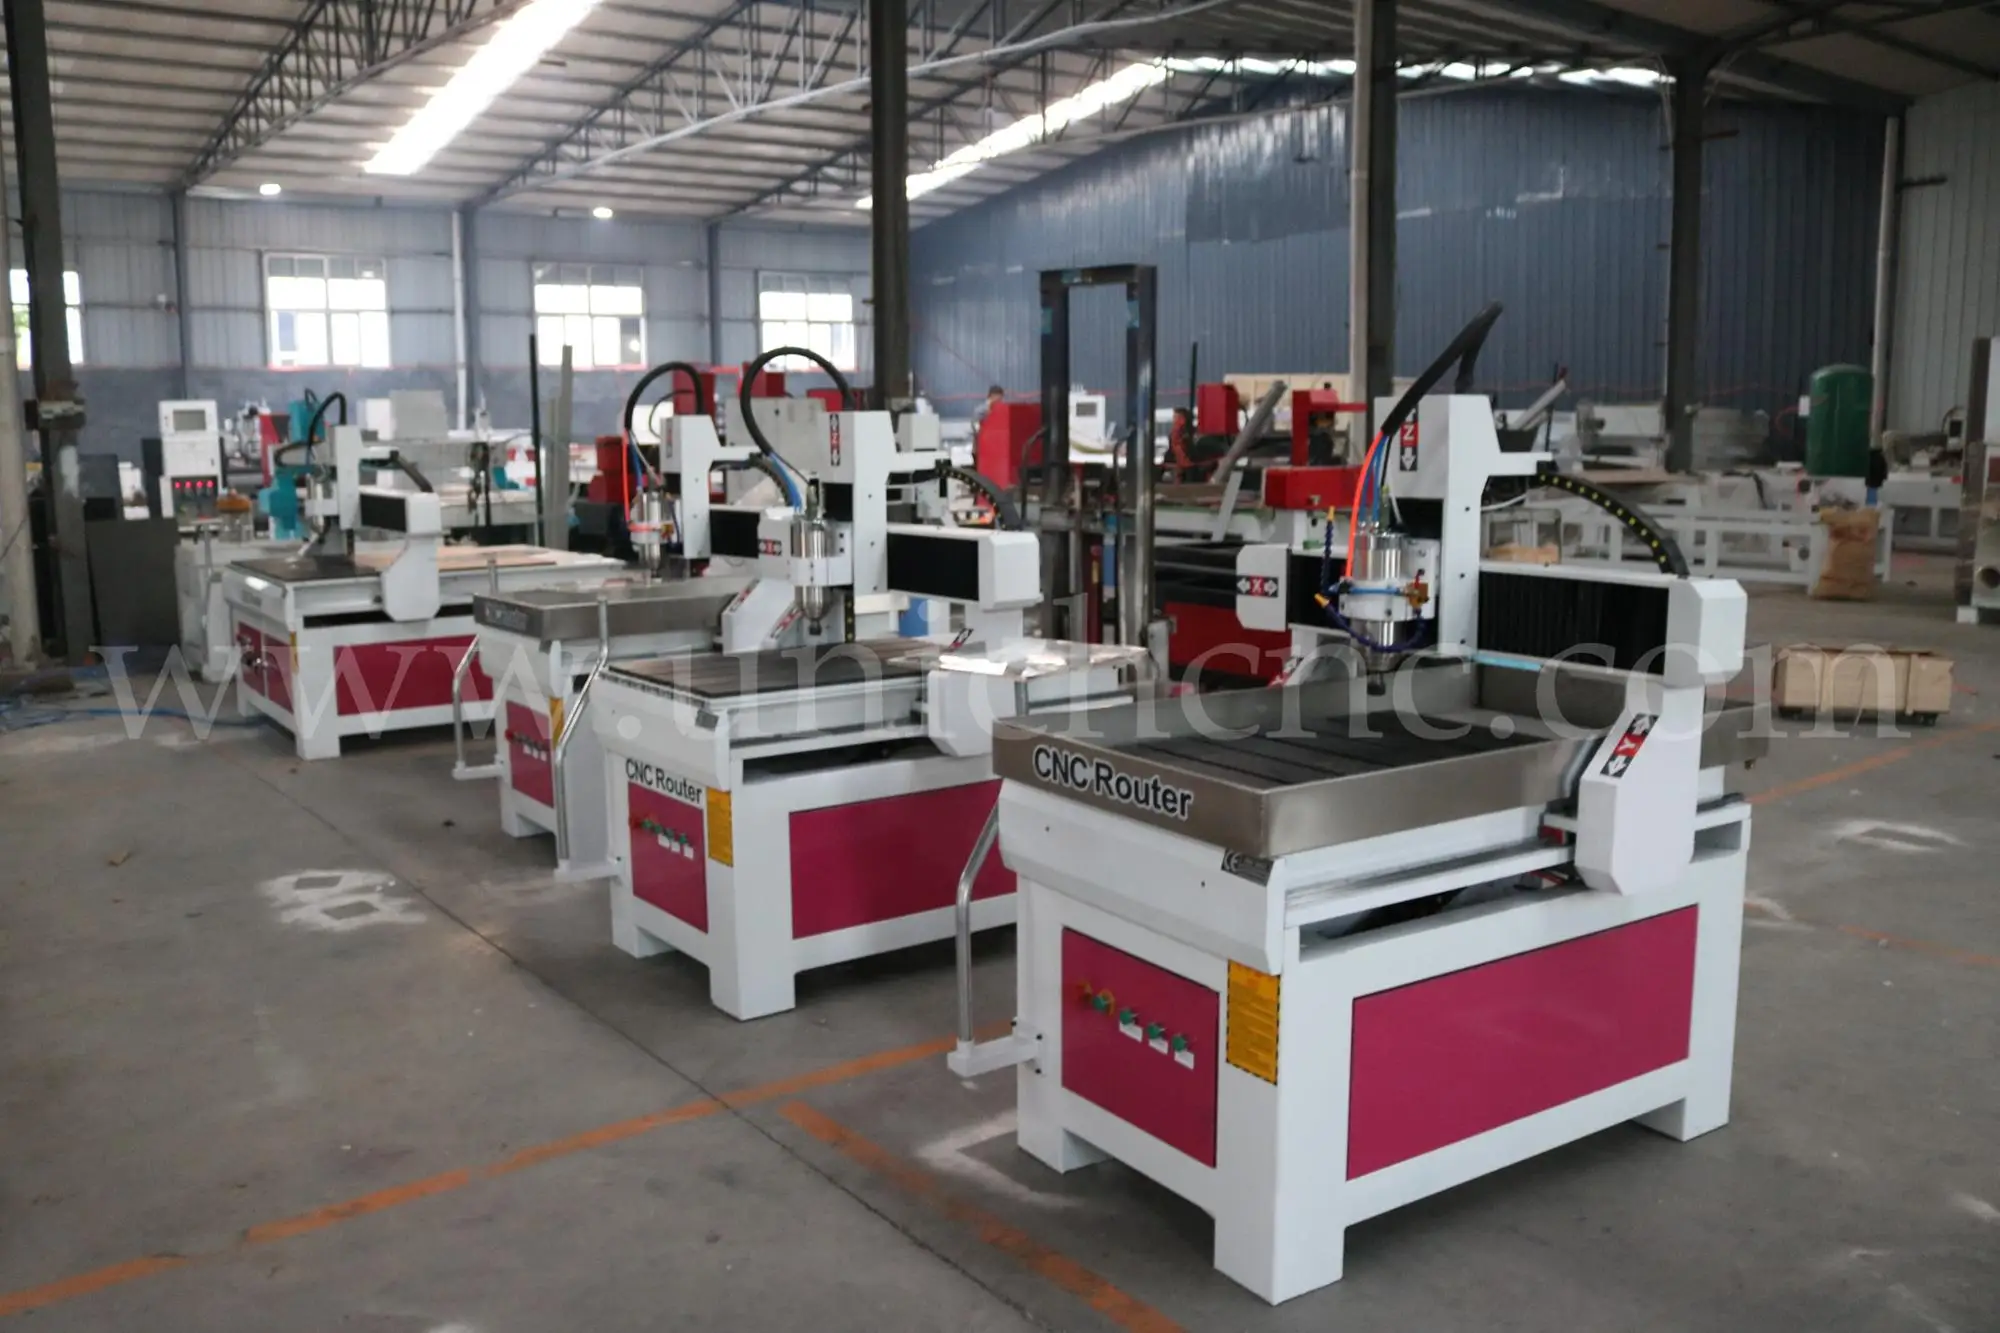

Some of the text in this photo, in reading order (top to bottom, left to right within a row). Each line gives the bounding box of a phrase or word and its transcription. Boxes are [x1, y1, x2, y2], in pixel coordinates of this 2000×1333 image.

[1402, 423, 1415, 441] Z
[625, 757, 703, 804] CNC Router
[1034, 745, 1193, 819] CNC Router
